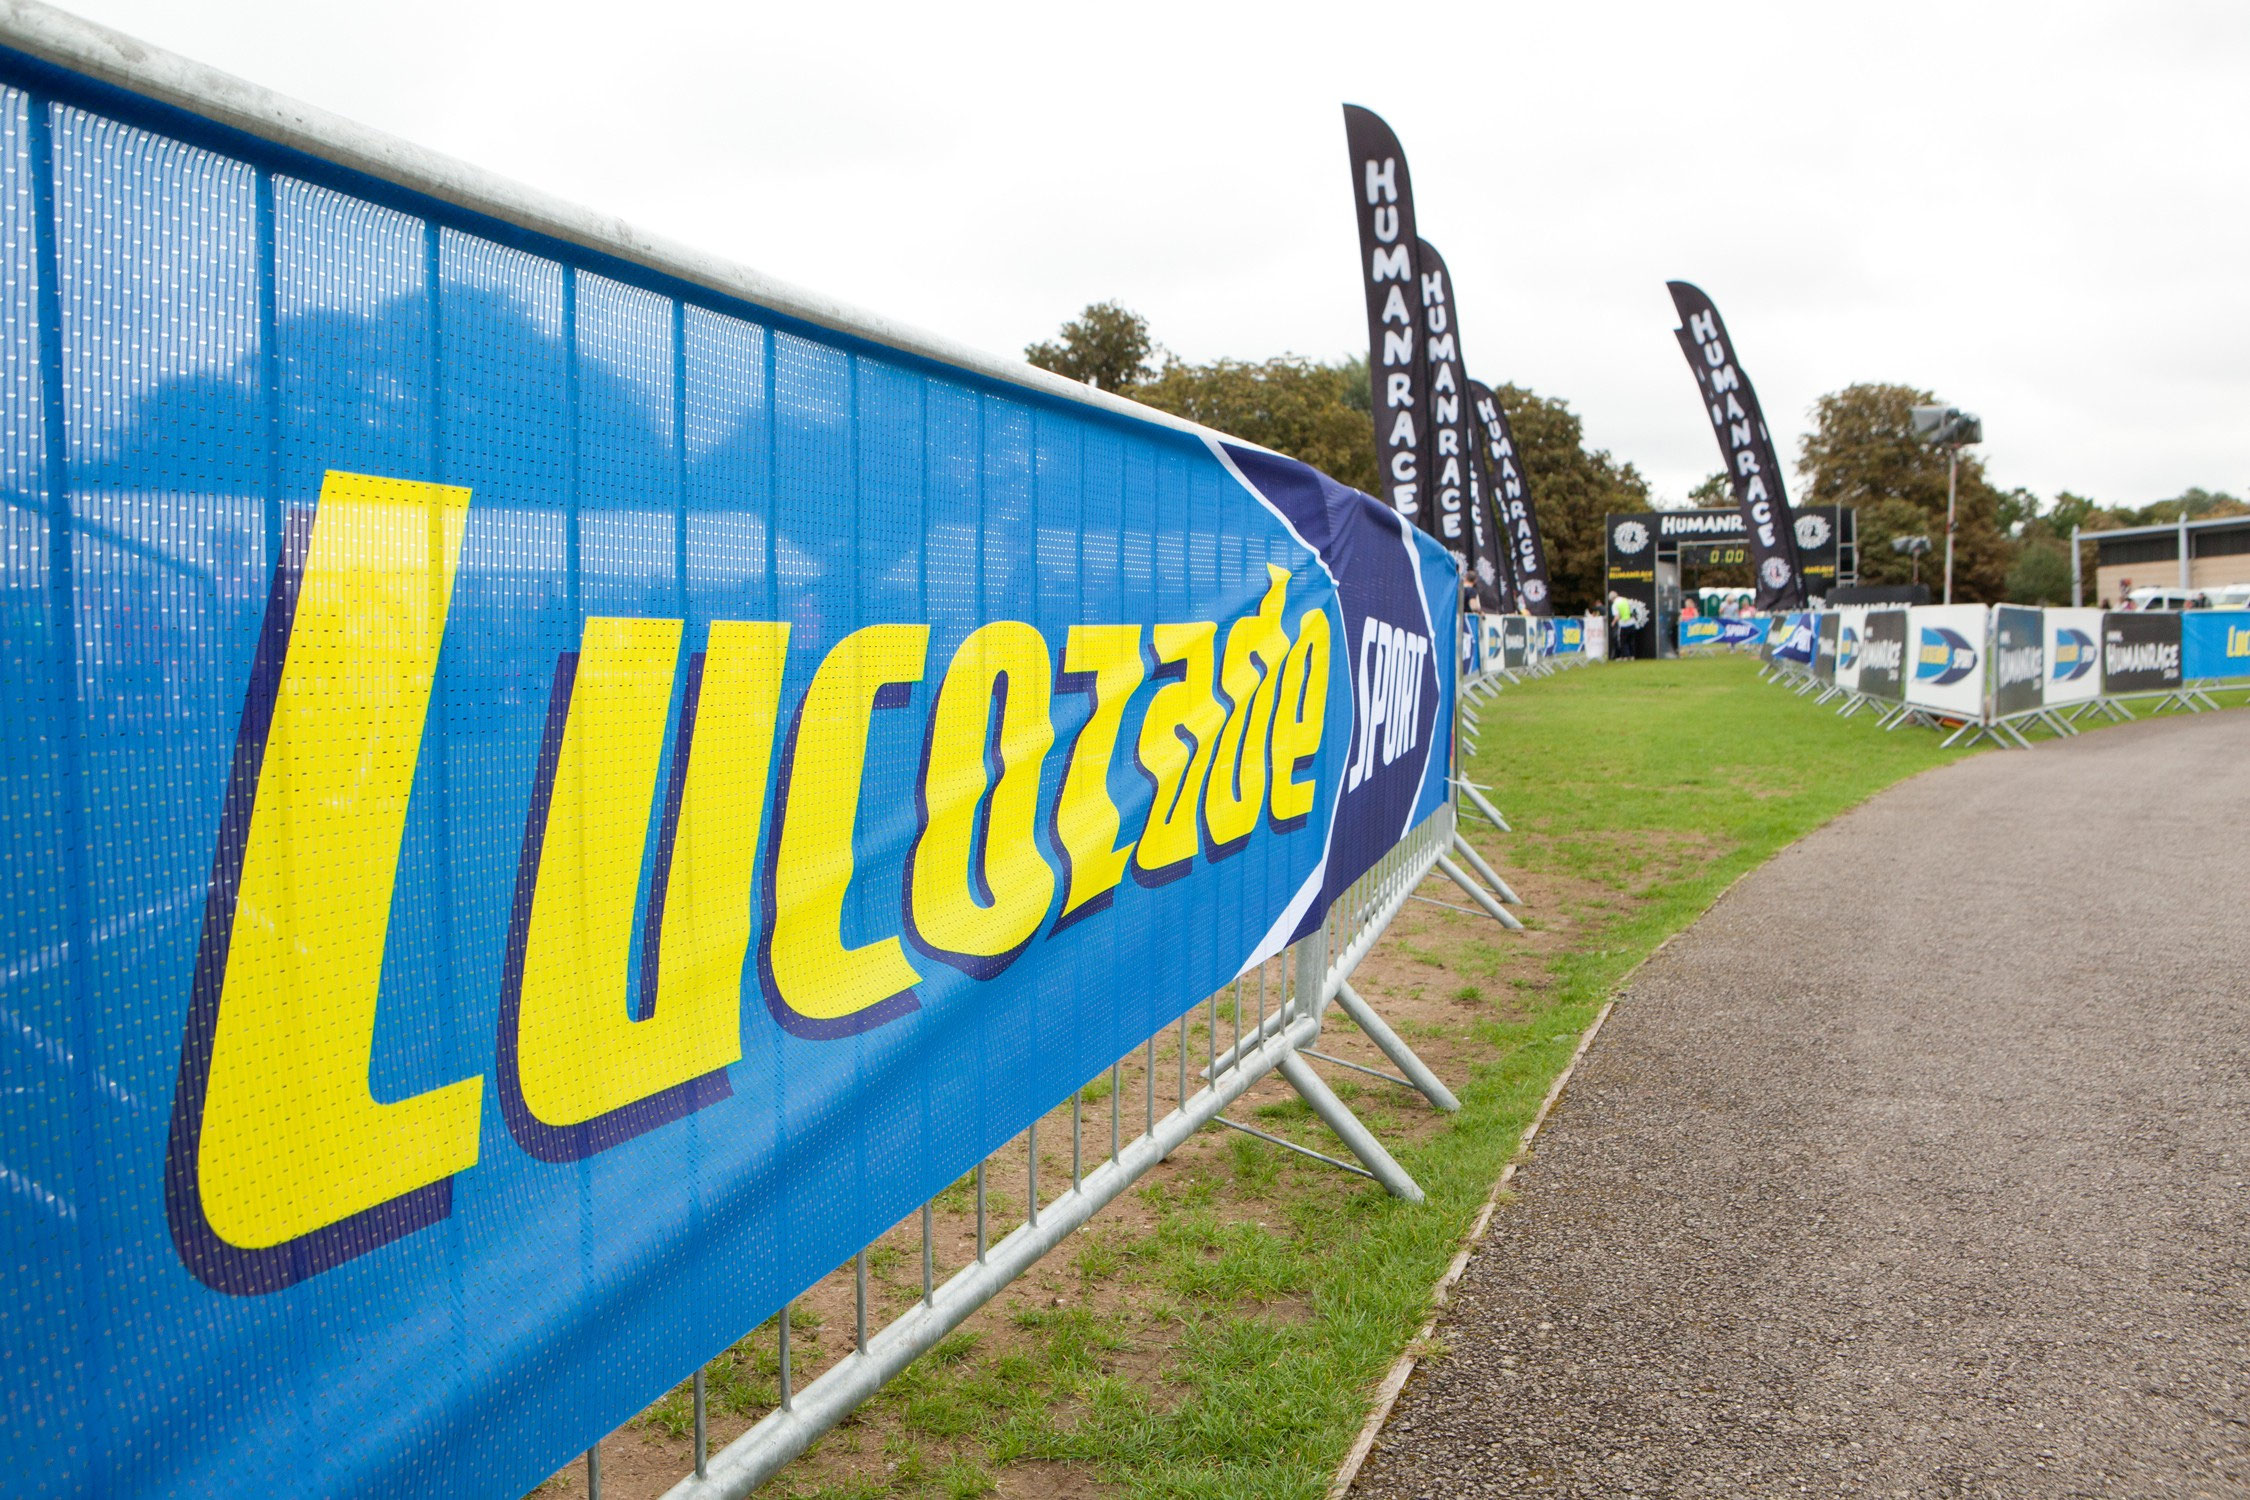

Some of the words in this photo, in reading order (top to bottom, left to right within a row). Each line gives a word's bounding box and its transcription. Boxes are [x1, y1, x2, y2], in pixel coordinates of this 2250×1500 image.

[1365, 157, 1419, 515] HUMANRACE
[1421, 270, 1462, 538] HUMANRACE
[1690, 309, 1776, 548] HUMANRACE
[1476, 397, 1537, 573] HUMANRACE
[1661, 514, 1747, 536] HUMANR
[198, 469, 1332, 1250] Lucozade
[1348, 616, 1428, 794] SPORT
